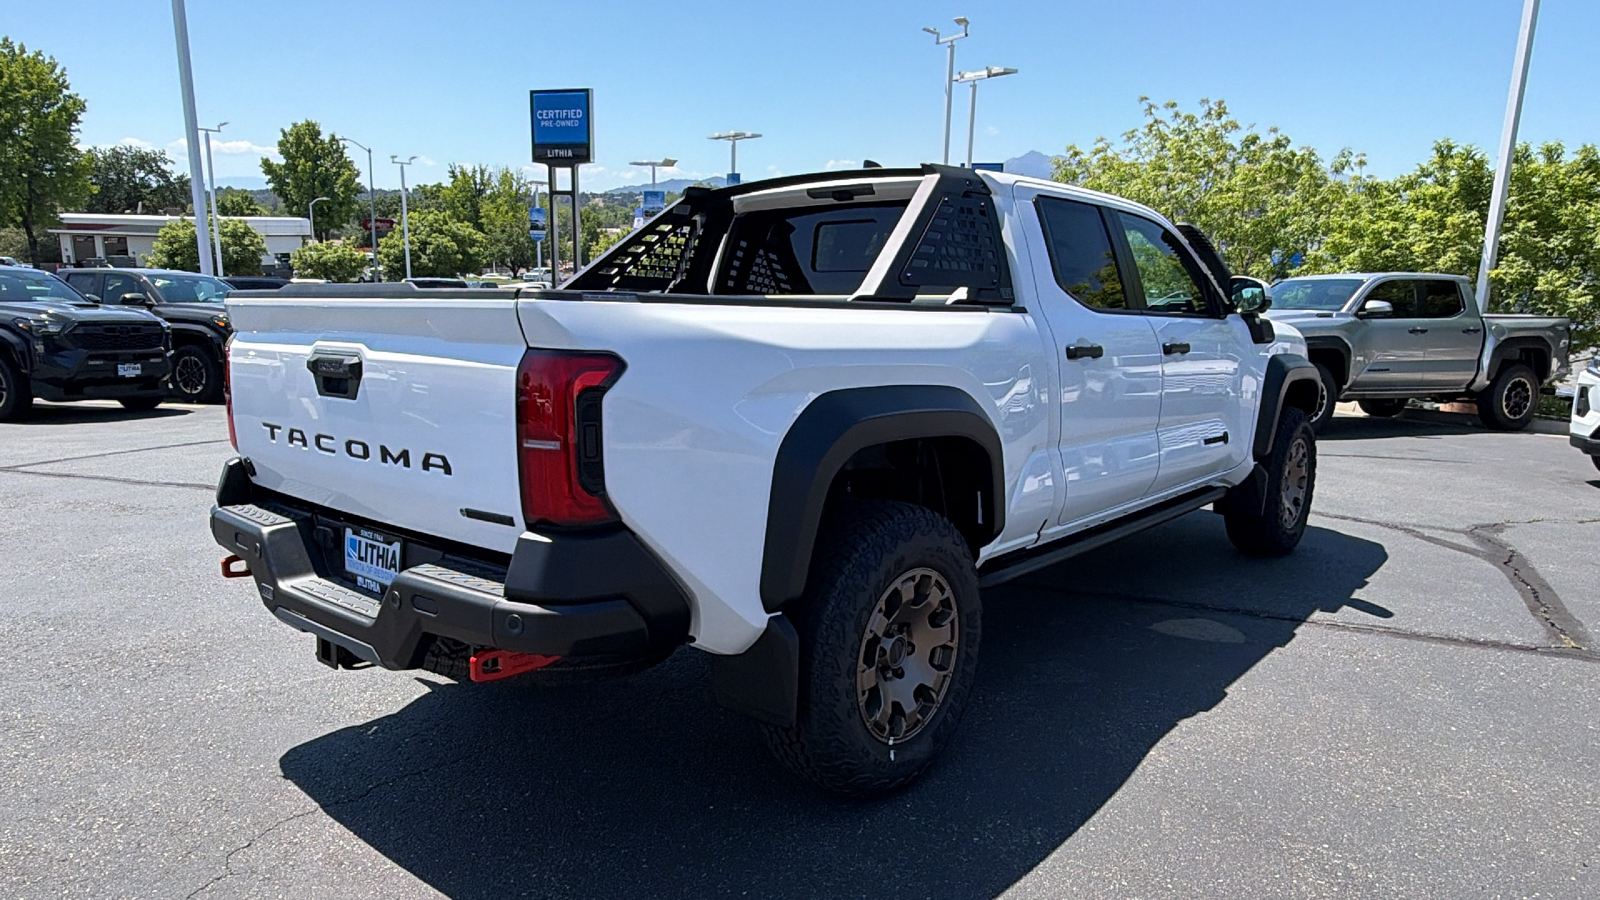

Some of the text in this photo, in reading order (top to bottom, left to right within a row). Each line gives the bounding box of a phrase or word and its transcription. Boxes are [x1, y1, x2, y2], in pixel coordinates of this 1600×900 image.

[536, 109, 583, 119] CERTIFIED
[547, 149, 573, 158] LITHIA
[262, 422, 452, 476] TACOMA
[357, 539, 398, 573] LITHIA
